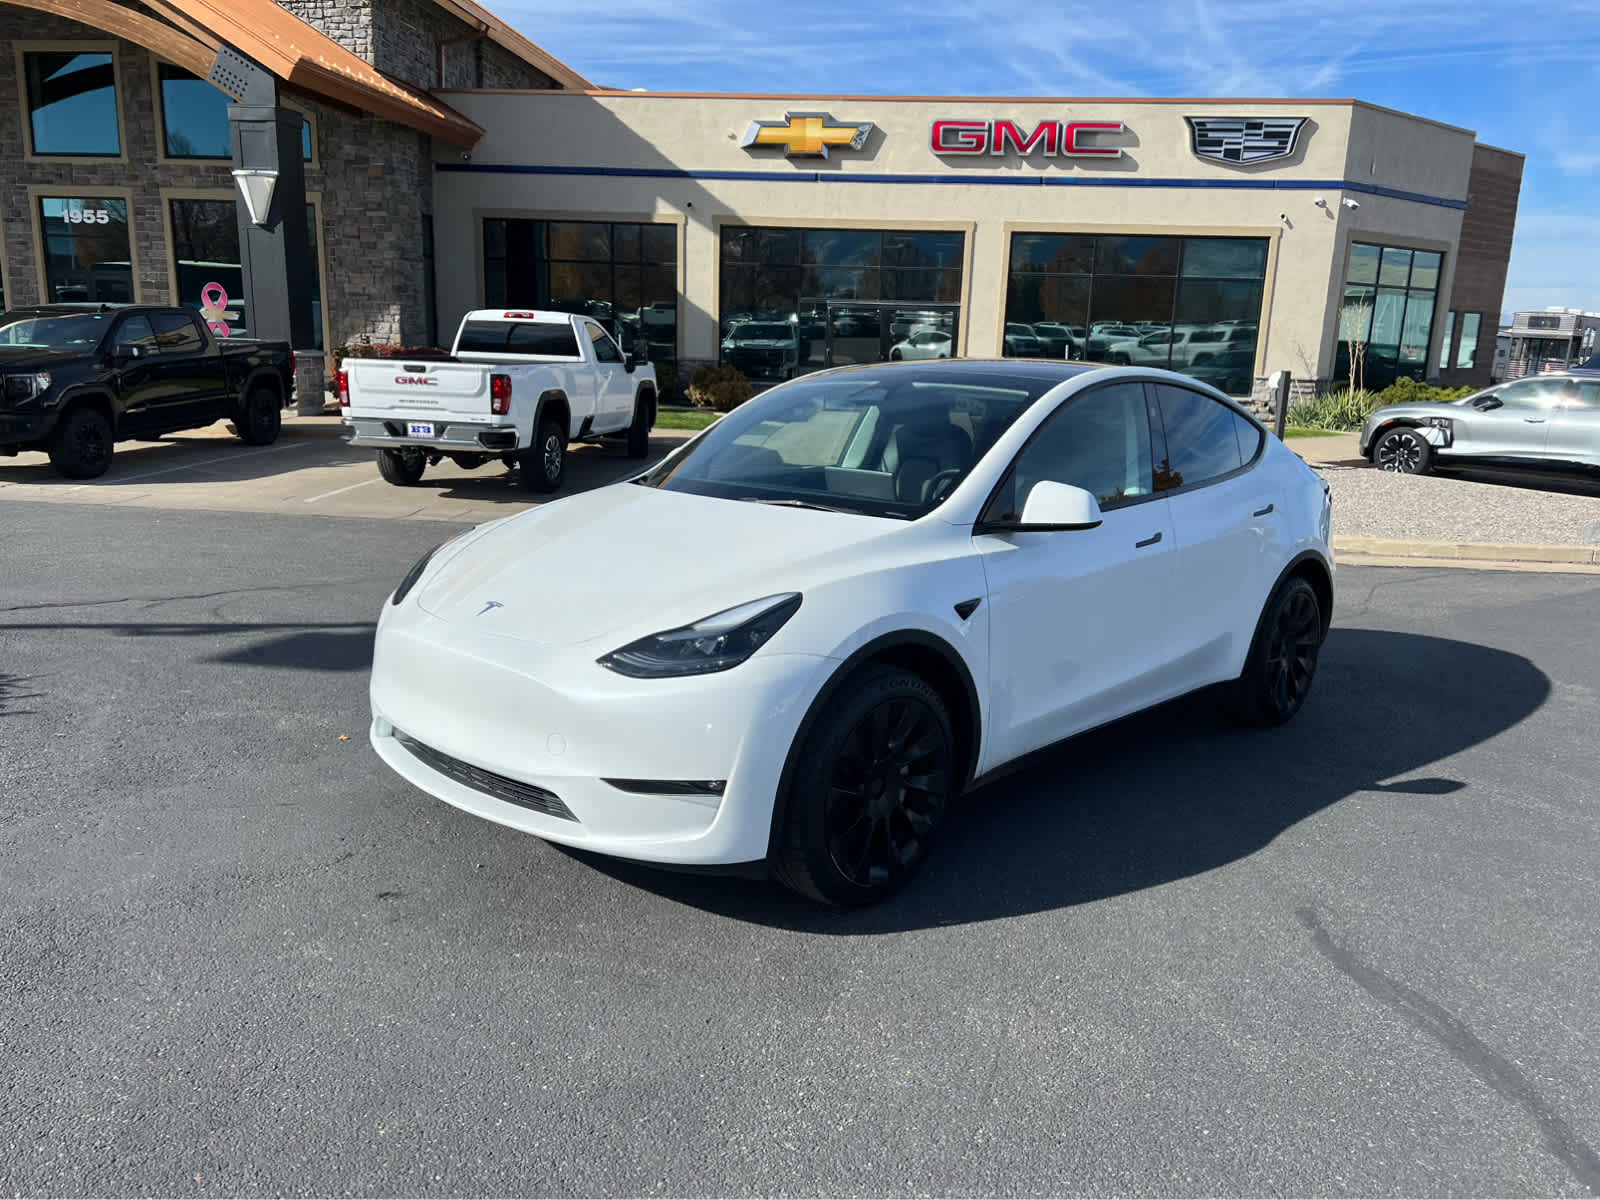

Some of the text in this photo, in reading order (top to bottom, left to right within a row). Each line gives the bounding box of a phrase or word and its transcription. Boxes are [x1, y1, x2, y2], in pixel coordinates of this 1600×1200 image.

[929, 119, 1125, 158] GMC
[62, 209, 109, 224] 1955
[394, 375, 439, 386] GMC
